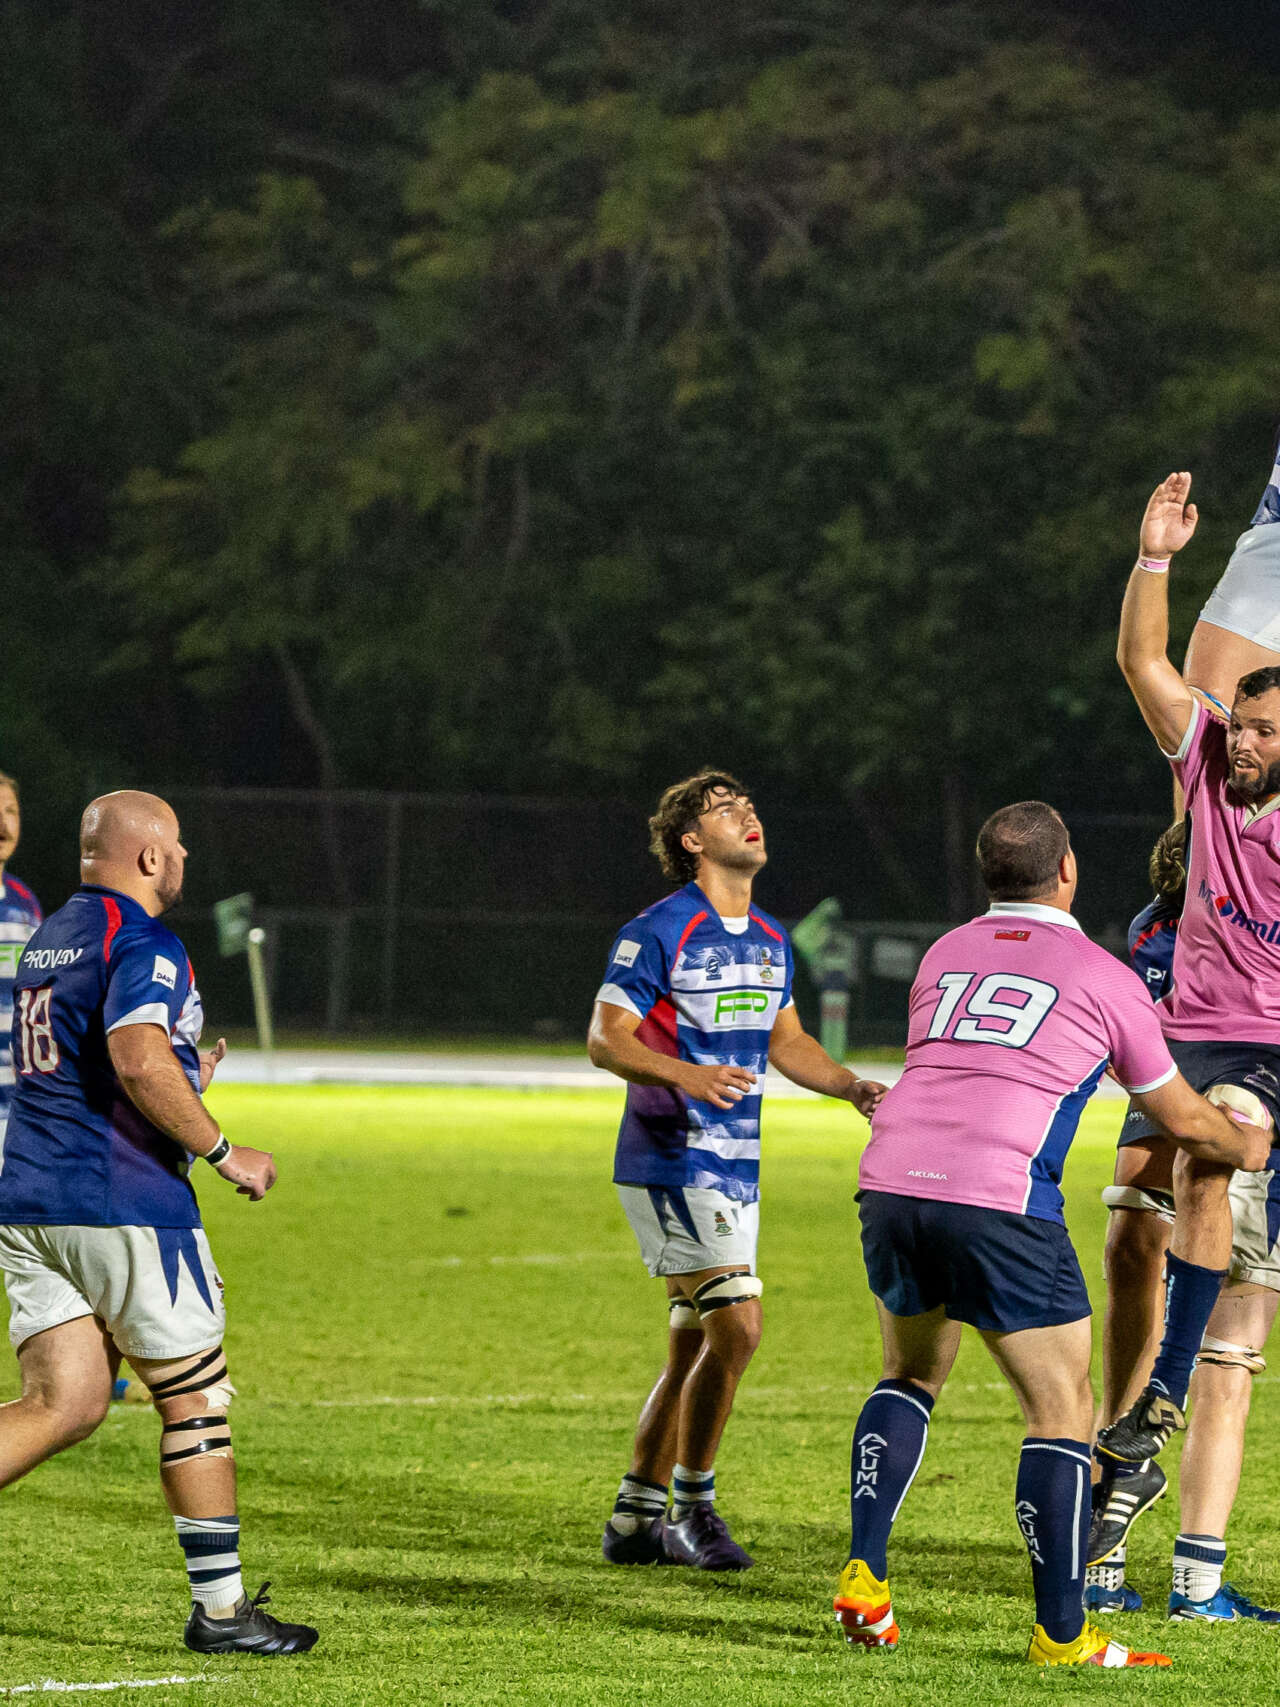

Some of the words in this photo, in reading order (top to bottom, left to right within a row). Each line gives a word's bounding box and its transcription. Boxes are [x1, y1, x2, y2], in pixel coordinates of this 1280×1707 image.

[18, 986, 60, 1076] 18
[926, 972, 1059, 1050] 19
[906, 1170, 949, 1181] AKUMA
[854, 1432, 888, 1500] AKUMA
